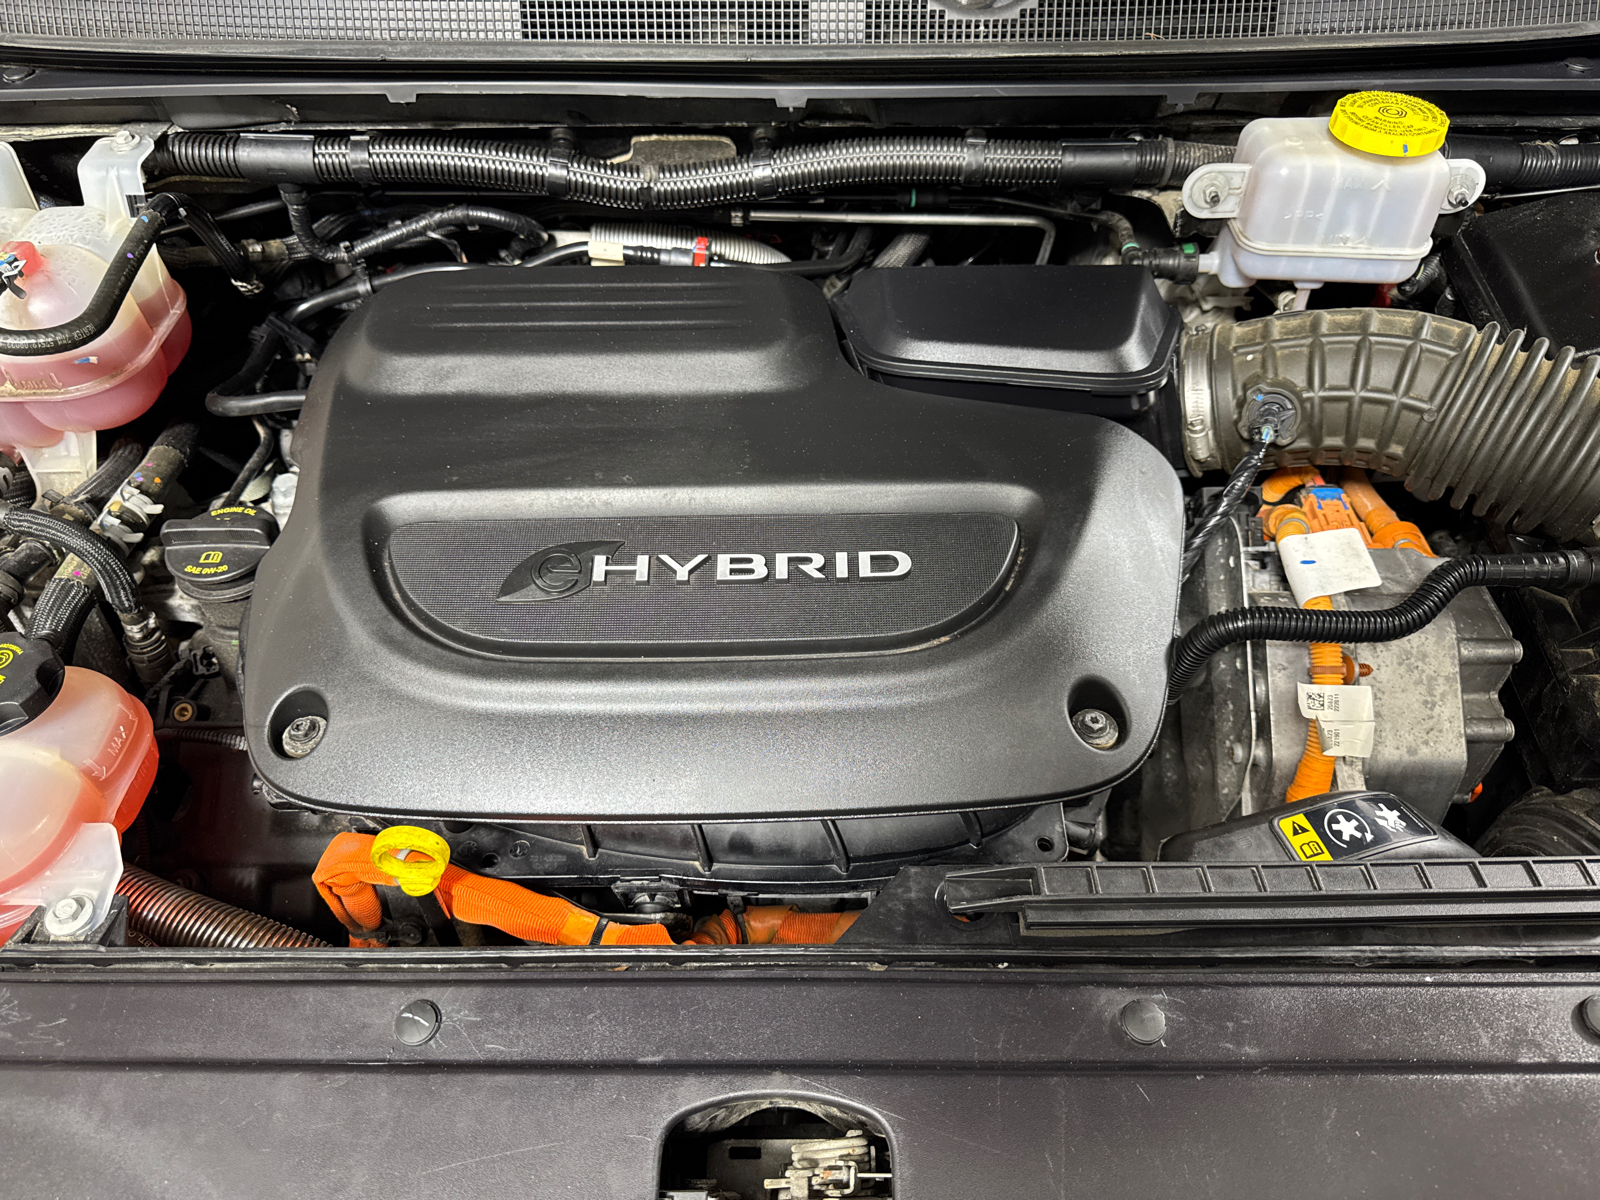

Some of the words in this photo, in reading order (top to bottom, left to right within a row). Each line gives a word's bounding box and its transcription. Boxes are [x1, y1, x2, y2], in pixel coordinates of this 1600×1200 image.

[211, 506, 245, 517] ENGINE
[244, 507, 257, 516] OIL
[184, 565, 202, 574] SAE
[107, 725, 129, 756] MAX
